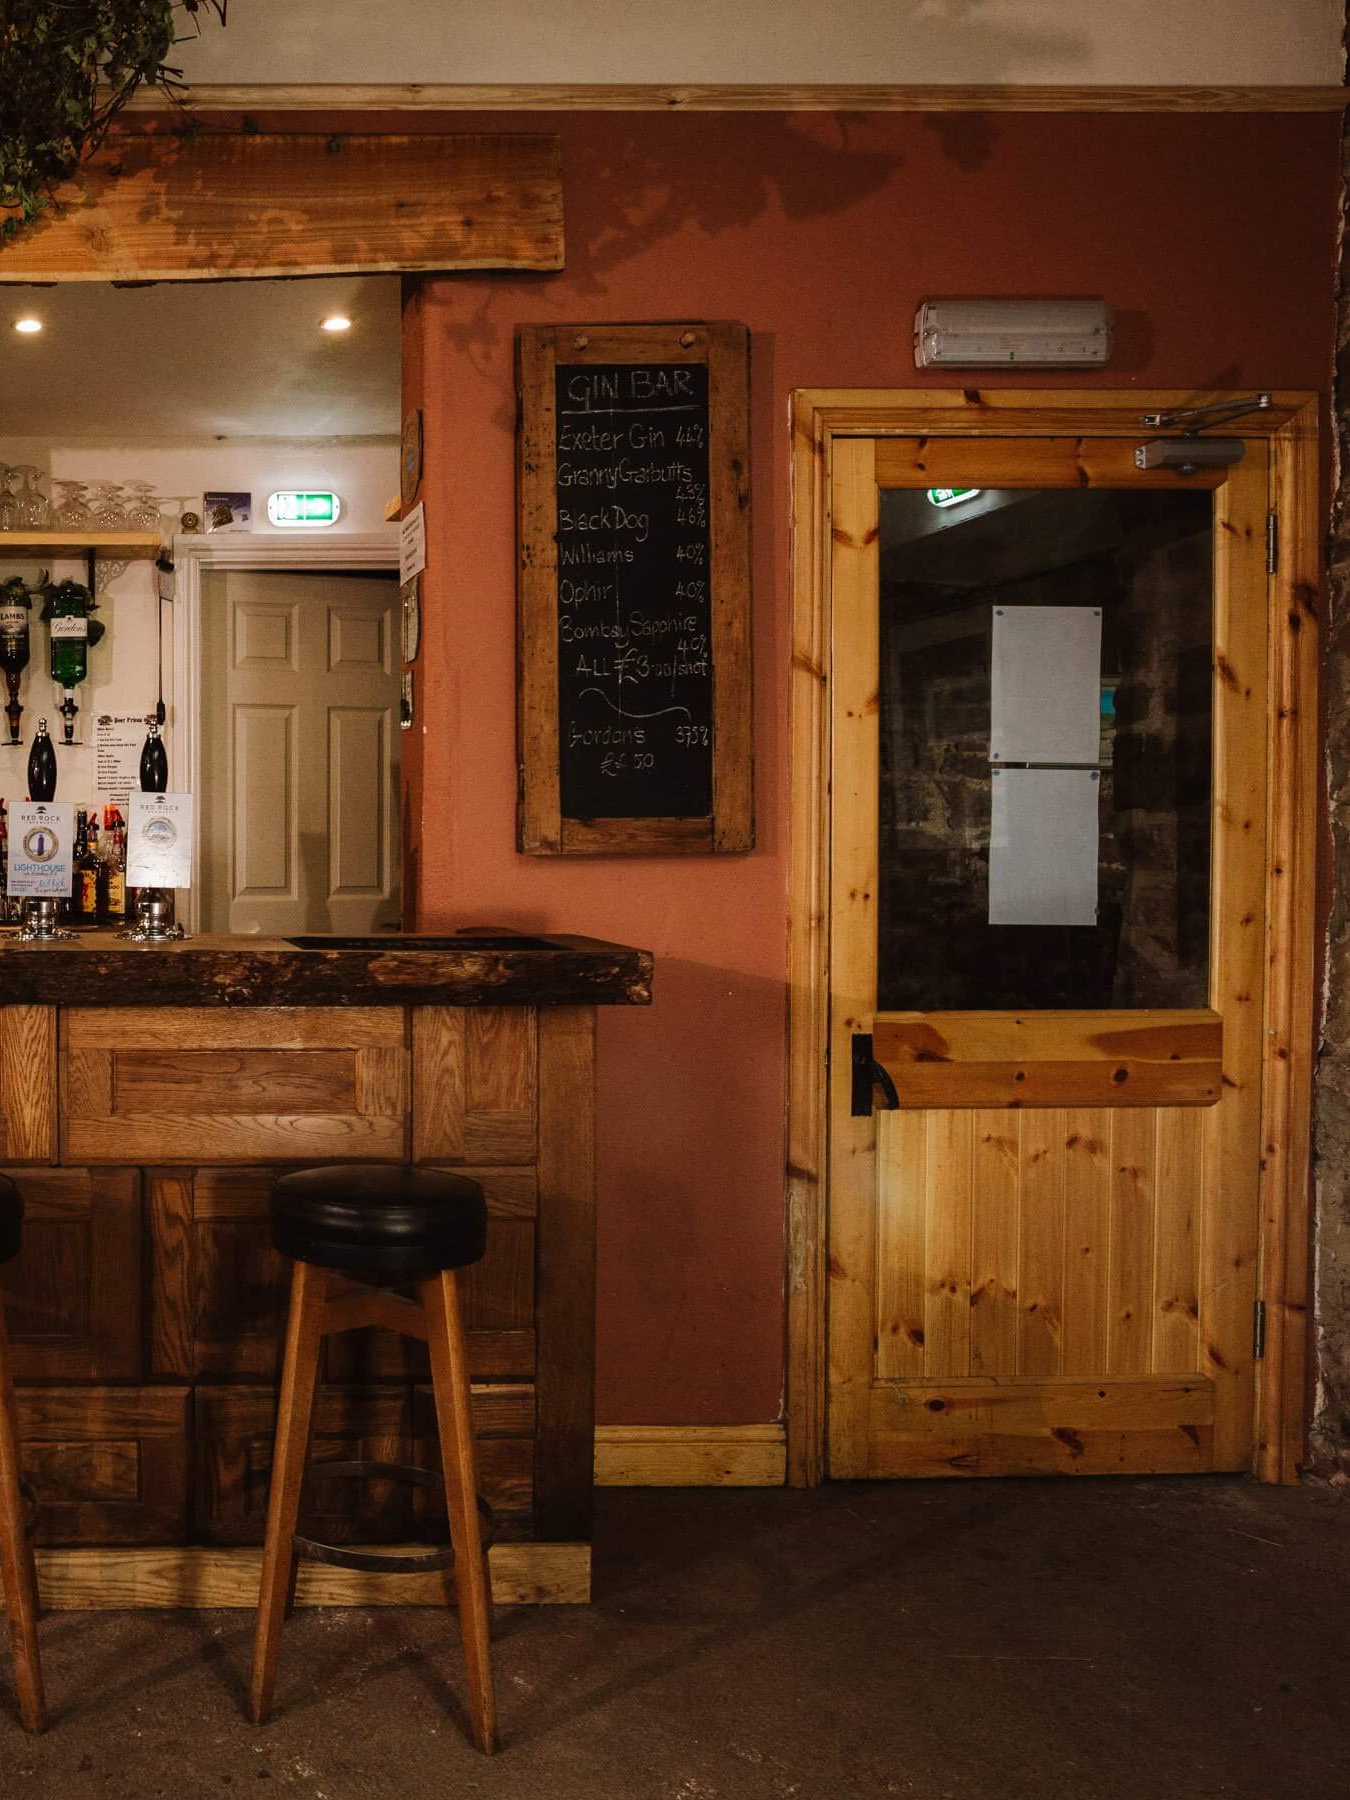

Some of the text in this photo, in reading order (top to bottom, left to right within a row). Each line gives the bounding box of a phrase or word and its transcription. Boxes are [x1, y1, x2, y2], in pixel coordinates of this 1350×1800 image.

[568, 369, 694, 411] GIN BAR
[558, 423, 624, 451] Exeter
[628, 423, 666, 449] Gin
[557, 463, 618, 489] Granny
[611, 505, 650, 542] Dog
[559, 543, 635, 566] Williams
[559, 579, 614, 610] Ophir
[558, 610, 698, 649] Bombay Sapphire
[576, 654, 611, 677] ALL
[13, 863, 66, 873] LIGHTHOUSE
